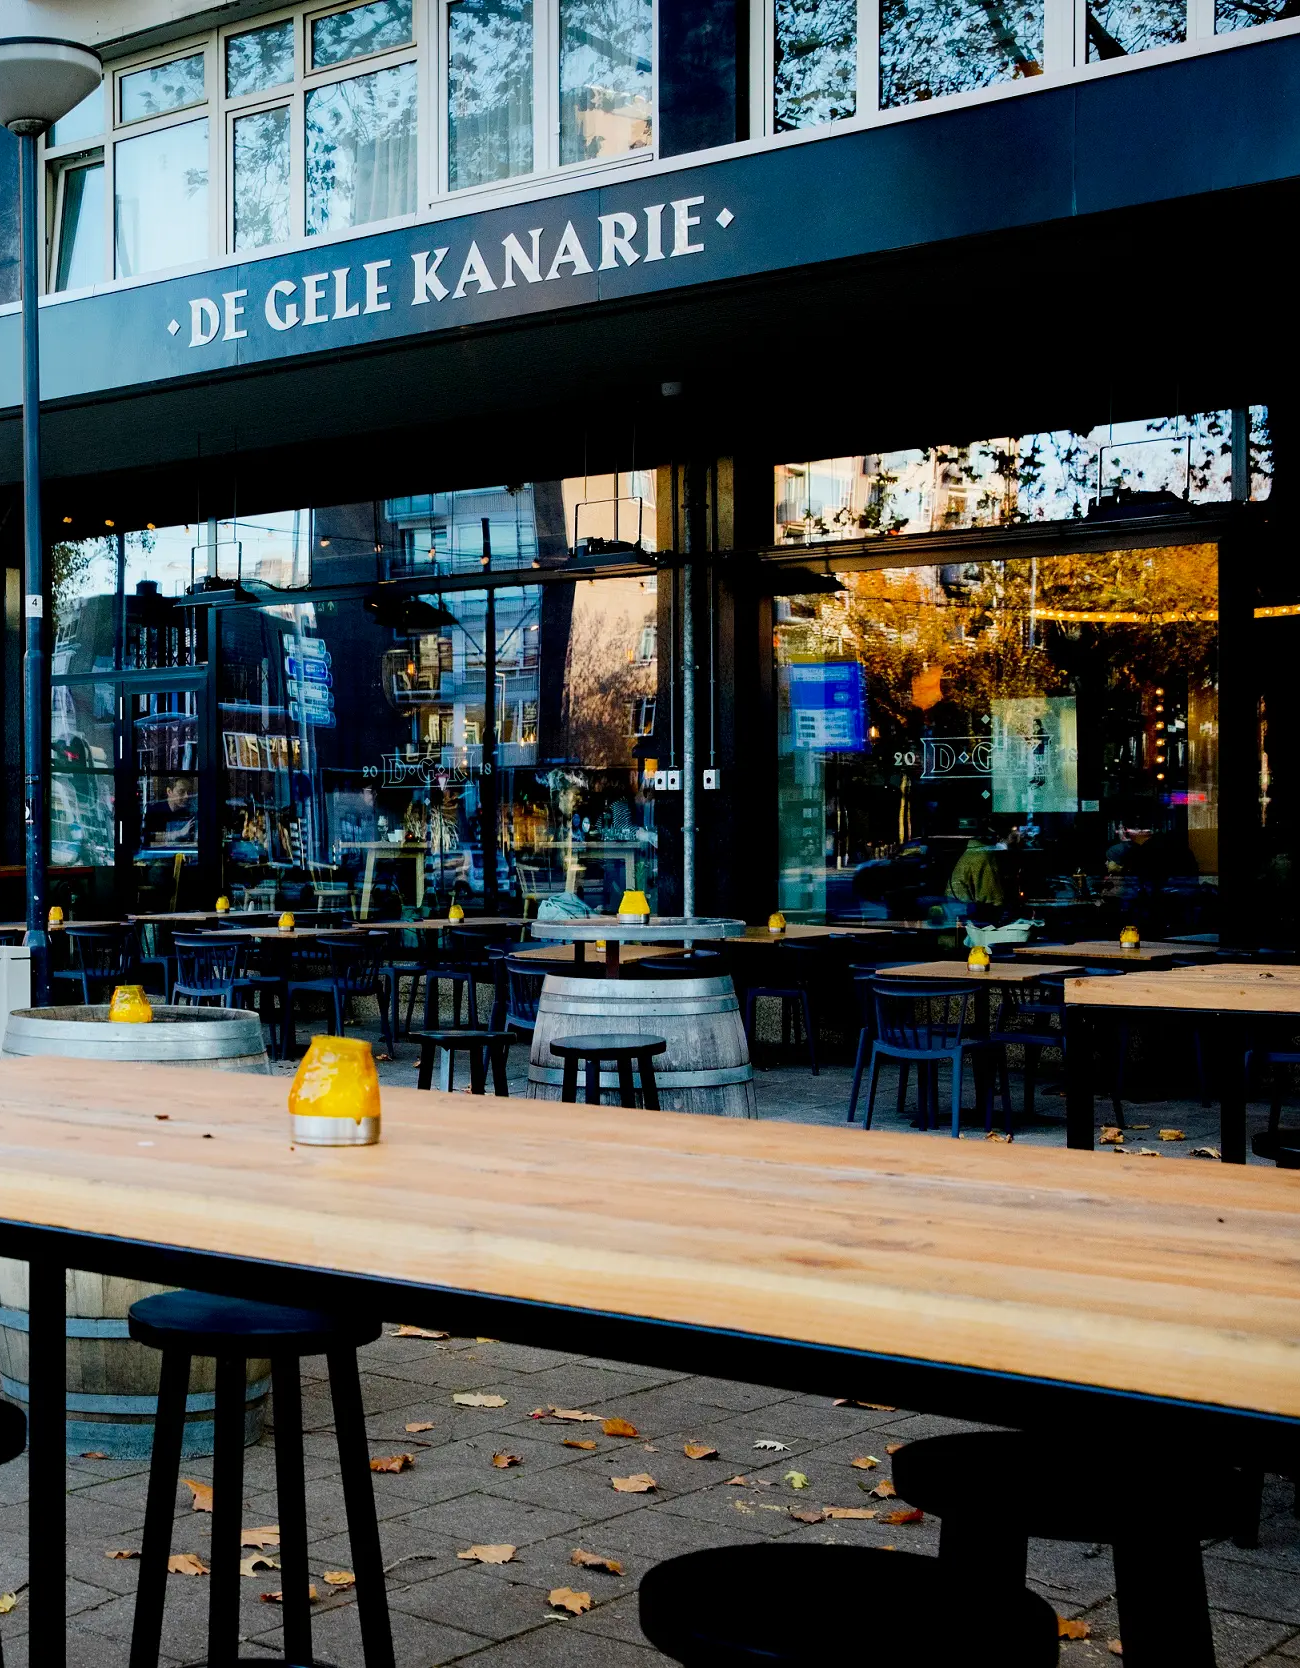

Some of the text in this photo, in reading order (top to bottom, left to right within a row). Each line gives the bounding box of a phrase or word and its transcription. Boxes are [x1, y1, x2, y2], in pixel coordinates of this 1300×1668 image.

[188, 195, 706, 348] DE GELE KANARIE
[893, 751, 916, 766] 20
[362, 765, 378, 778] 20
